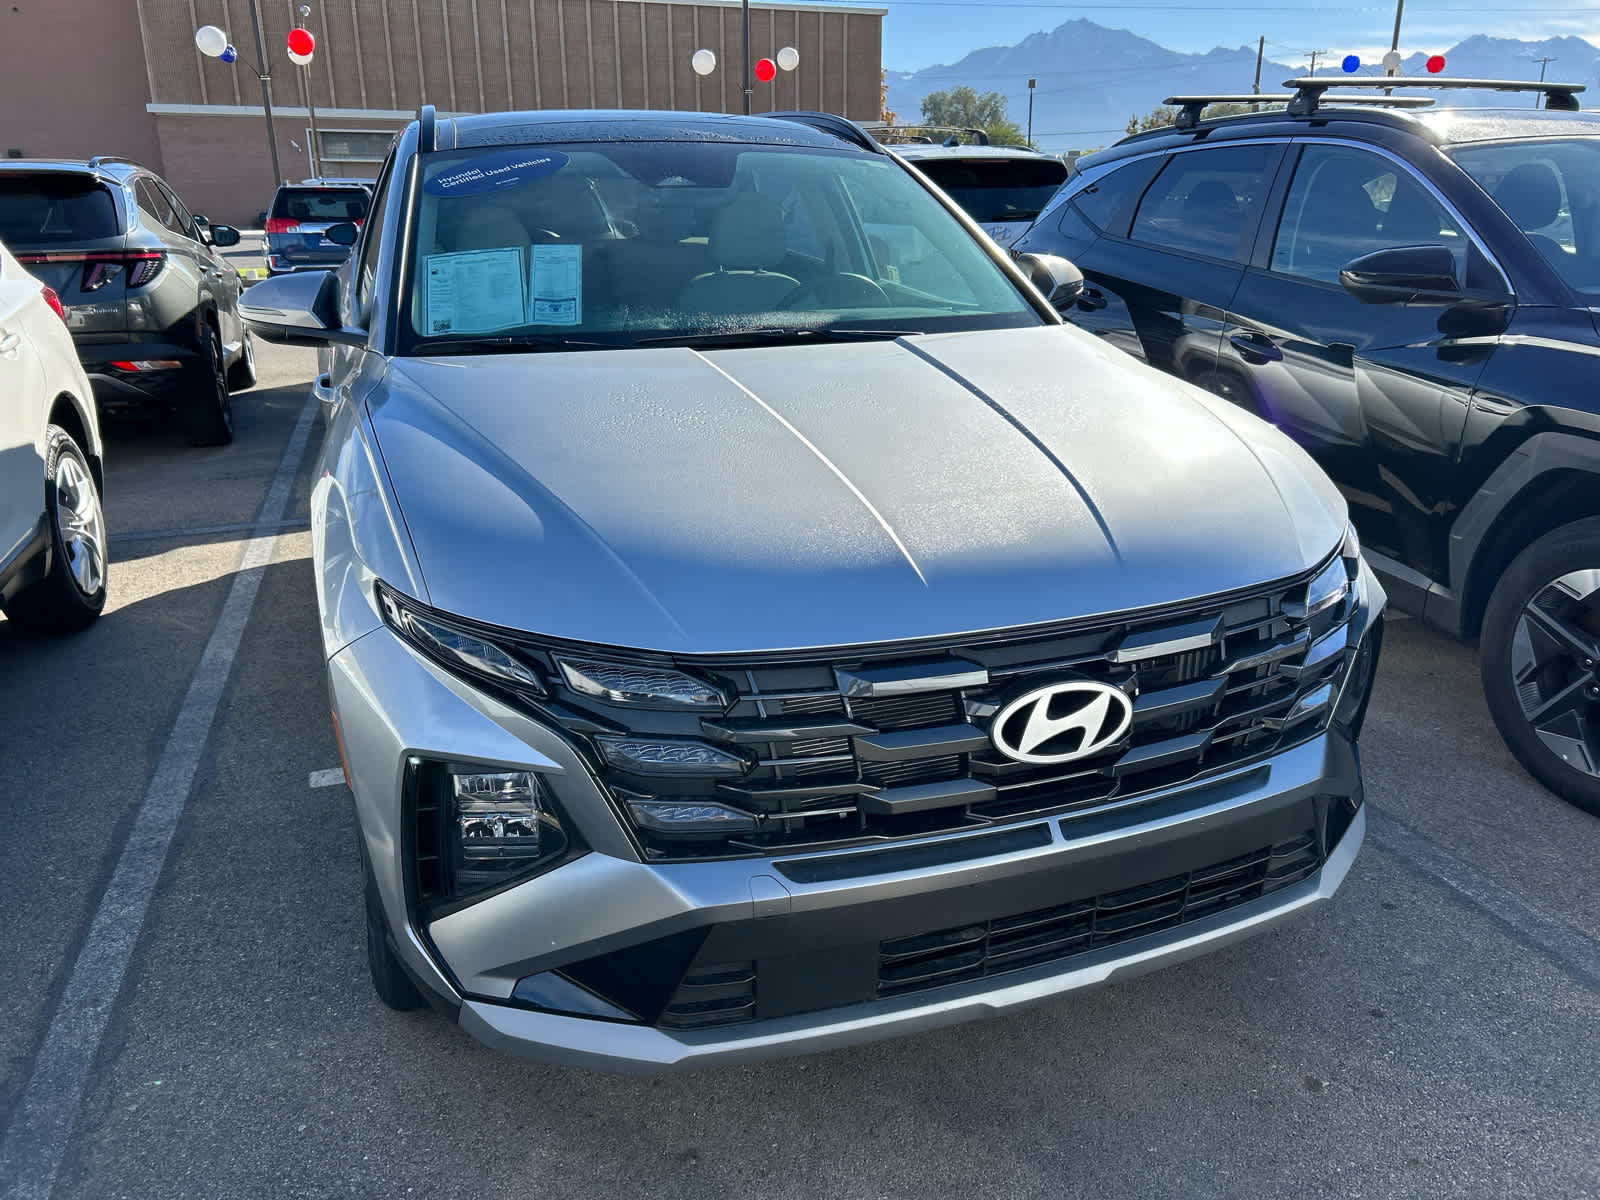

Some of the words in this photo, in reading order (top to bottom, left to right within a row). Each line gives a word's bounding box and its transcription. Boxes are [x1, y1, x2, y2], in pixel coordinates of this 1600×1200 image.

[438, 168, 481, 184] Hyundai
[442, 173, 485, 188] Certified
[485, 166, 511, 176] Used
[511, 157, 551, 169] Vehicles
